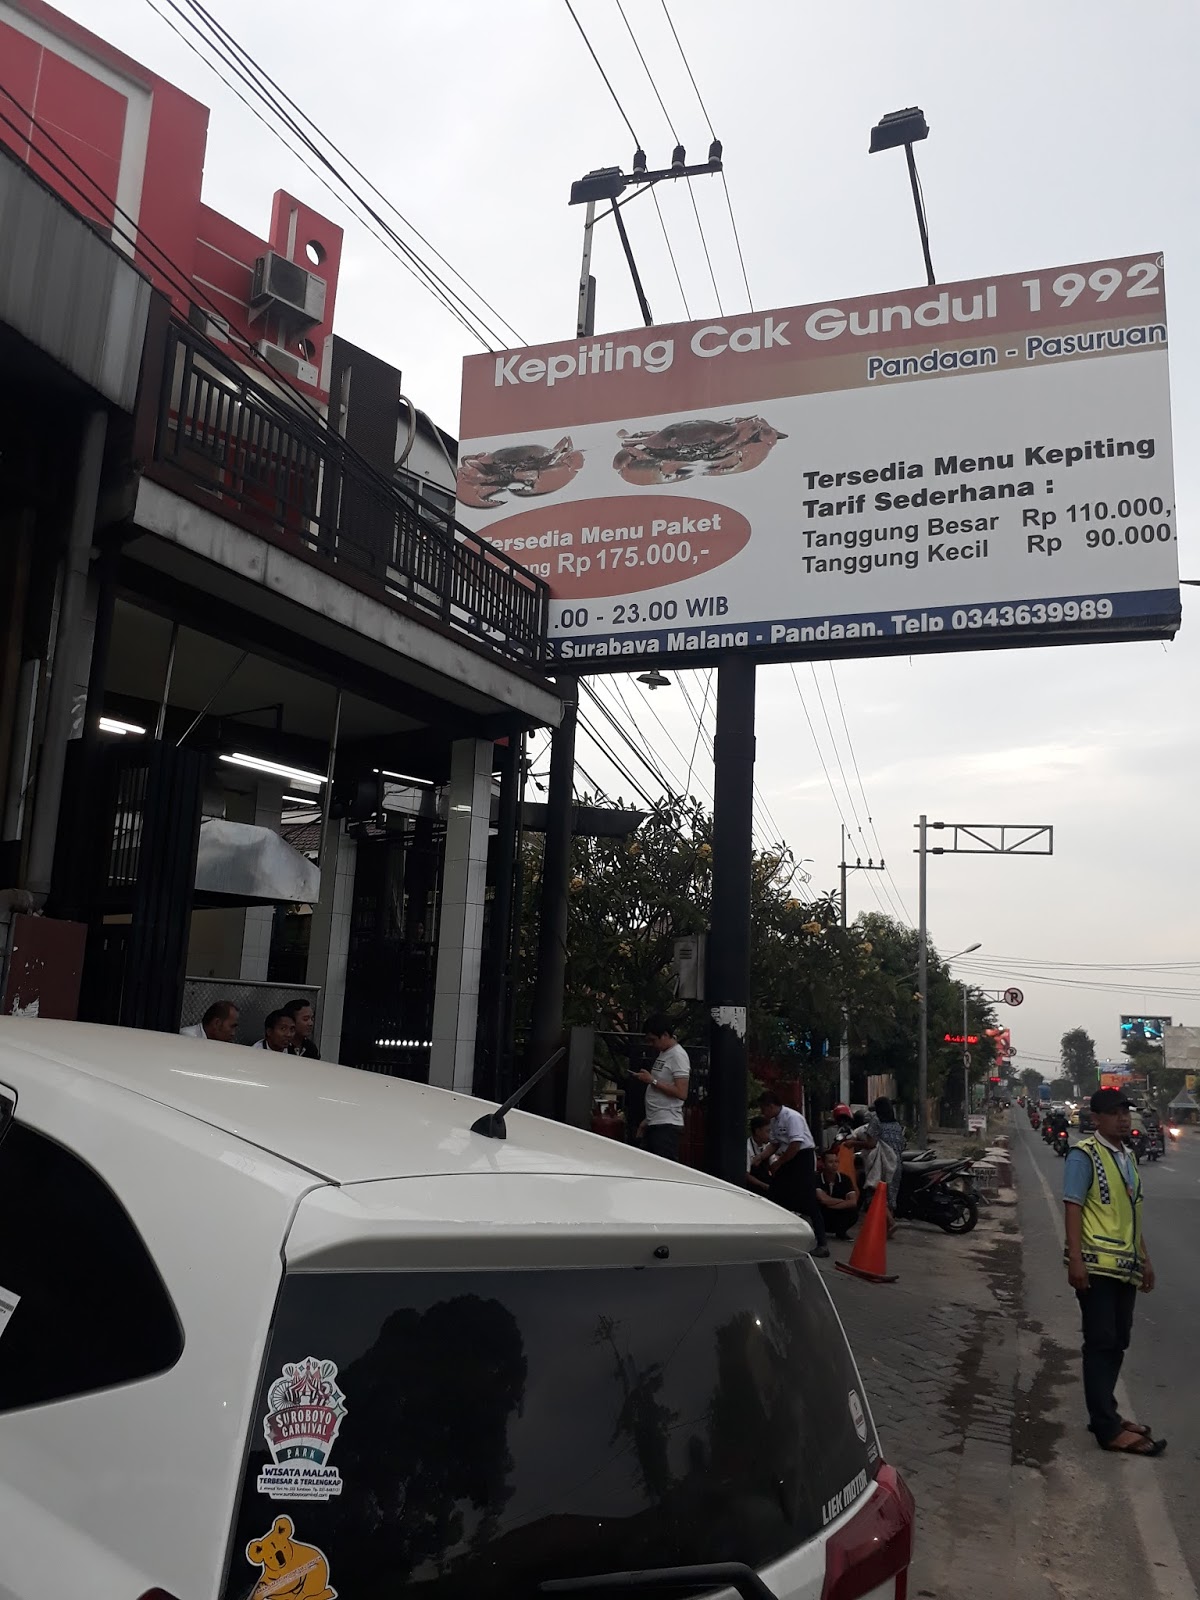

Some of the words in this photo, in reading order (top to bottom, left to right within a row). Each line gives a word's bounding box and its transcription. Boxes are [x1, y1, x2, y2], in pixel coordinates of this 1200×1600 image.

[495, 339, 674, 387] Kepiting
[691, 317, 791, 358] Cak
[804, 286, 997, 342] Gundul
[1022, 262, 1160, 313] 1992
[867, 345, 997, 380] Pandaan
[1025, 323, 1167, 360] Pasuruan
[803, 461, 924, 490] Tersedia
[934, 451, 1014, 475] Menu
[1025, 437, 1156, 467] Kepiting
[802, 494, 866, 519] Tarif
[874, 478, 1035, 511] Sederhana
[581, 523, 643, 544] Menu
[651, 513, 722, 537] Paket
[803, 521, 919, 549] Tanggung
[927, 514, 1000, 537] Besar
[1022, 508, 1057, 530] Rp
[1066, 497, 1175, 523] 110.000,
[557, 552, 591, 577] Rp
[596, 540, 710, 569] 175.000,-
[802, 548, 919, 575] Tanggung
[927, 540, 989, 563] Kecil
[1027, 534, 1063, 556] Rp
[612, 600, 678, 625] 23.00
[685, 596, 729, 619] WIB
[770, 620, 884, 644] Pandaan.
[951, 598, 1114, 631] 0343639989
[275, 1409, 332, 1428] SUROBOYO
[281, 1422, 327, 1438] CARNIVAL
[286, 1447, 316, 1459] PARK
[259, 1477, 293, 1485] TERBESAR
[300, 1478, 341, 1486] TERLENGKAP
[264, 1467, 301, 1477] WISATA
[302, 1468, 337, 1478] MALAM
[822, 1491, 844, 1526] LIEK
